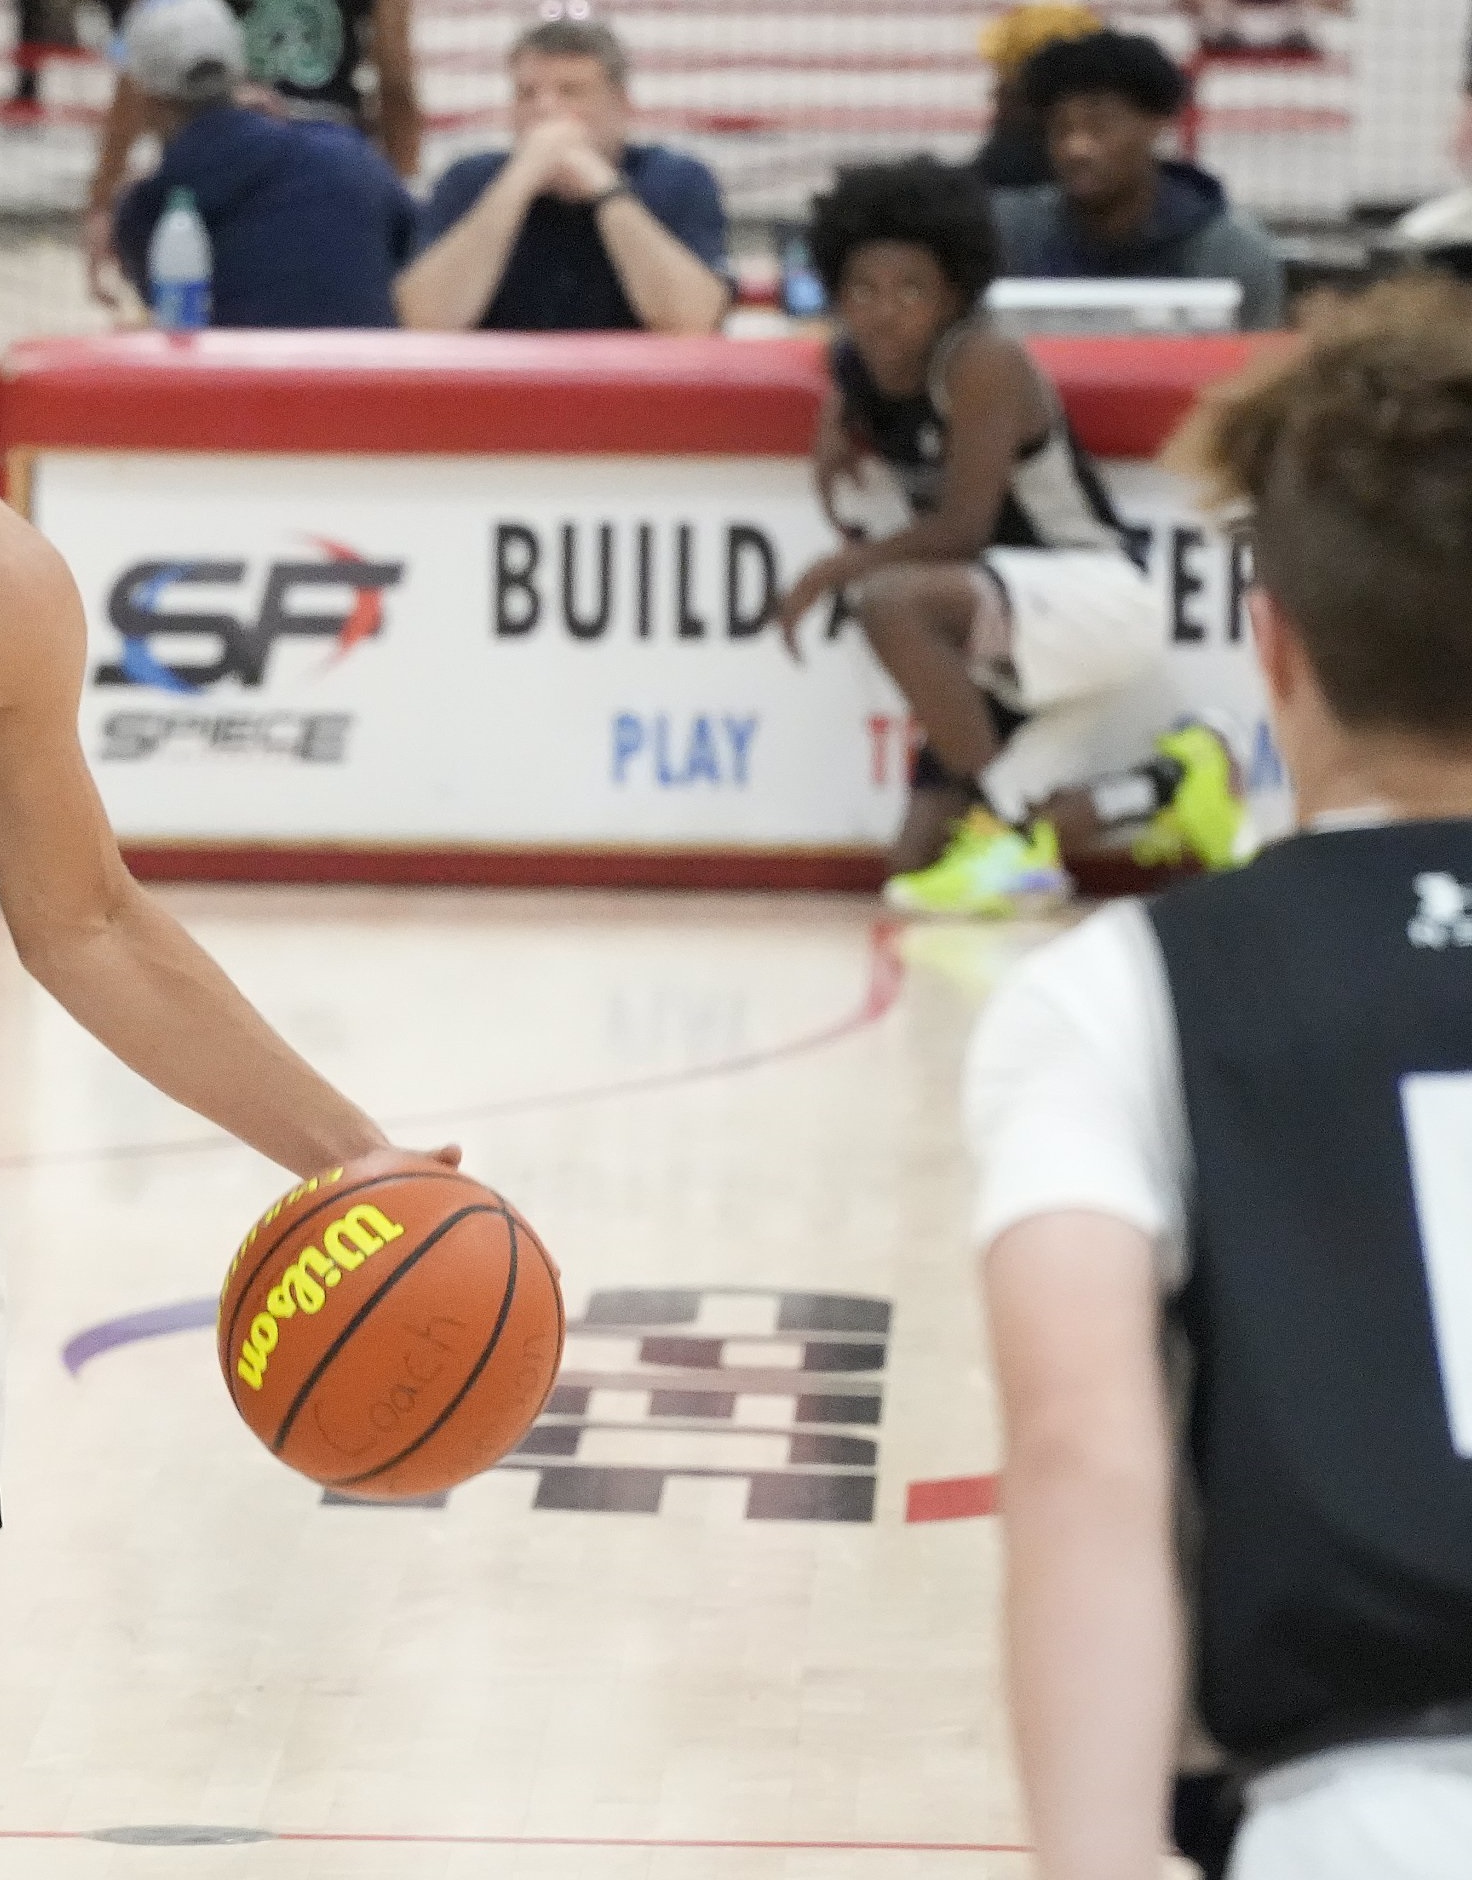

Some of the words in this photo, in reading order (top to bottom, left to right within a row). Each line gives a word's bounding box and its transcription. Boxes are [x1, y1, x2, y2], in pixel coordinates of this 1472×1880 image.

[494, 520, 780, 640] BUILD
[609, 711, 759, 787] PLAY
[237, 1203, 406, 1392] Wilson
[313, 1314, 468, 1458] Coach
